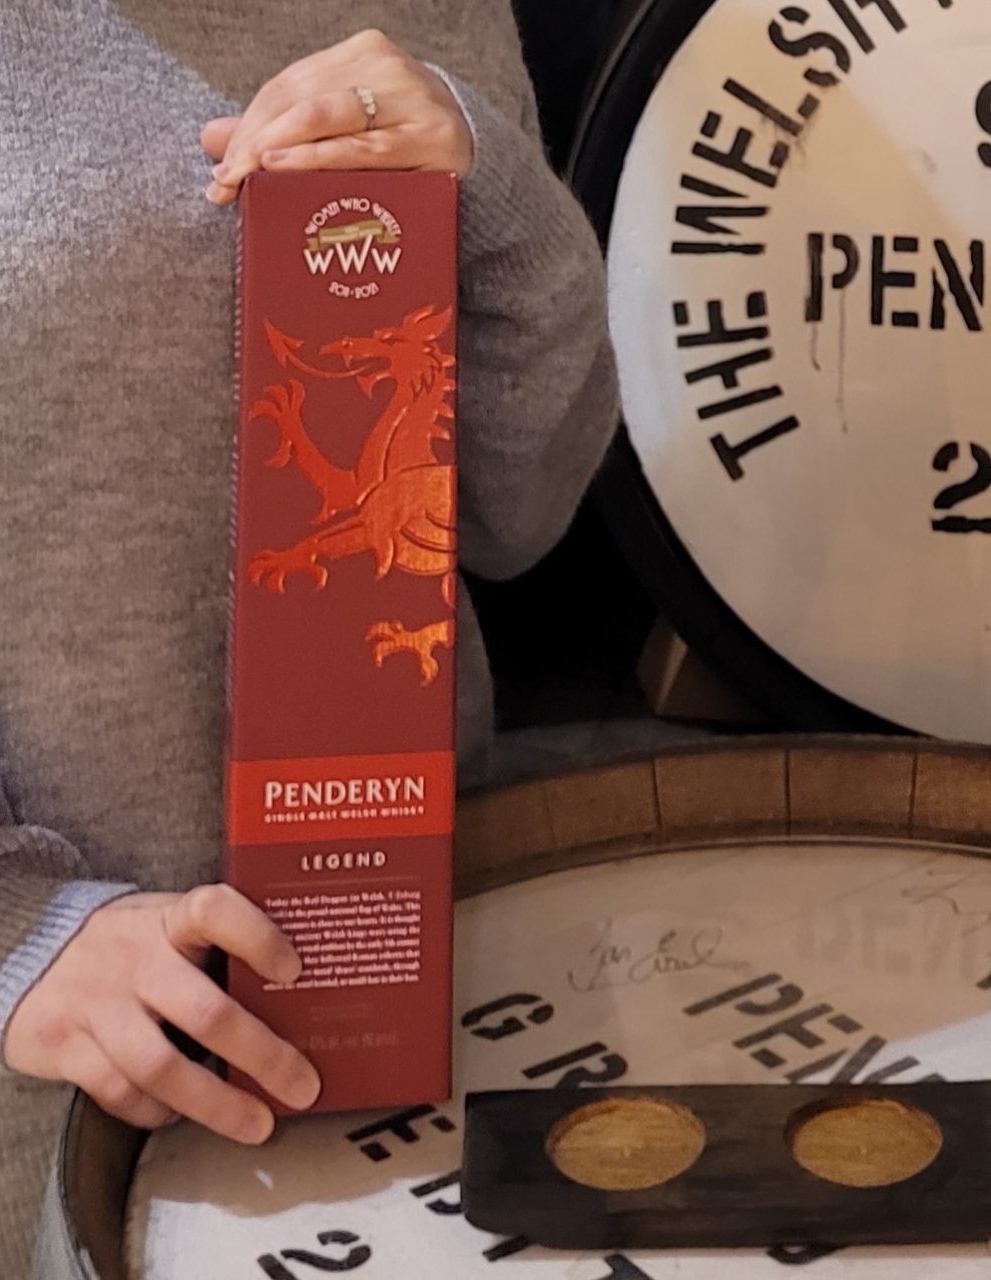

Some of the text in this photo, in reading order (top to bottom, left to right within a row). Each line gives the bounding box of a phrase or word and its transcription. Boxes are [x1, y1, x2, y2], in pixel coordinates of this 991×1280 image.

[672, 290, 800, 481] THE
[264, 776, 425, 810] PENDERYN
[301, 851, 387, 871] LEGEND
